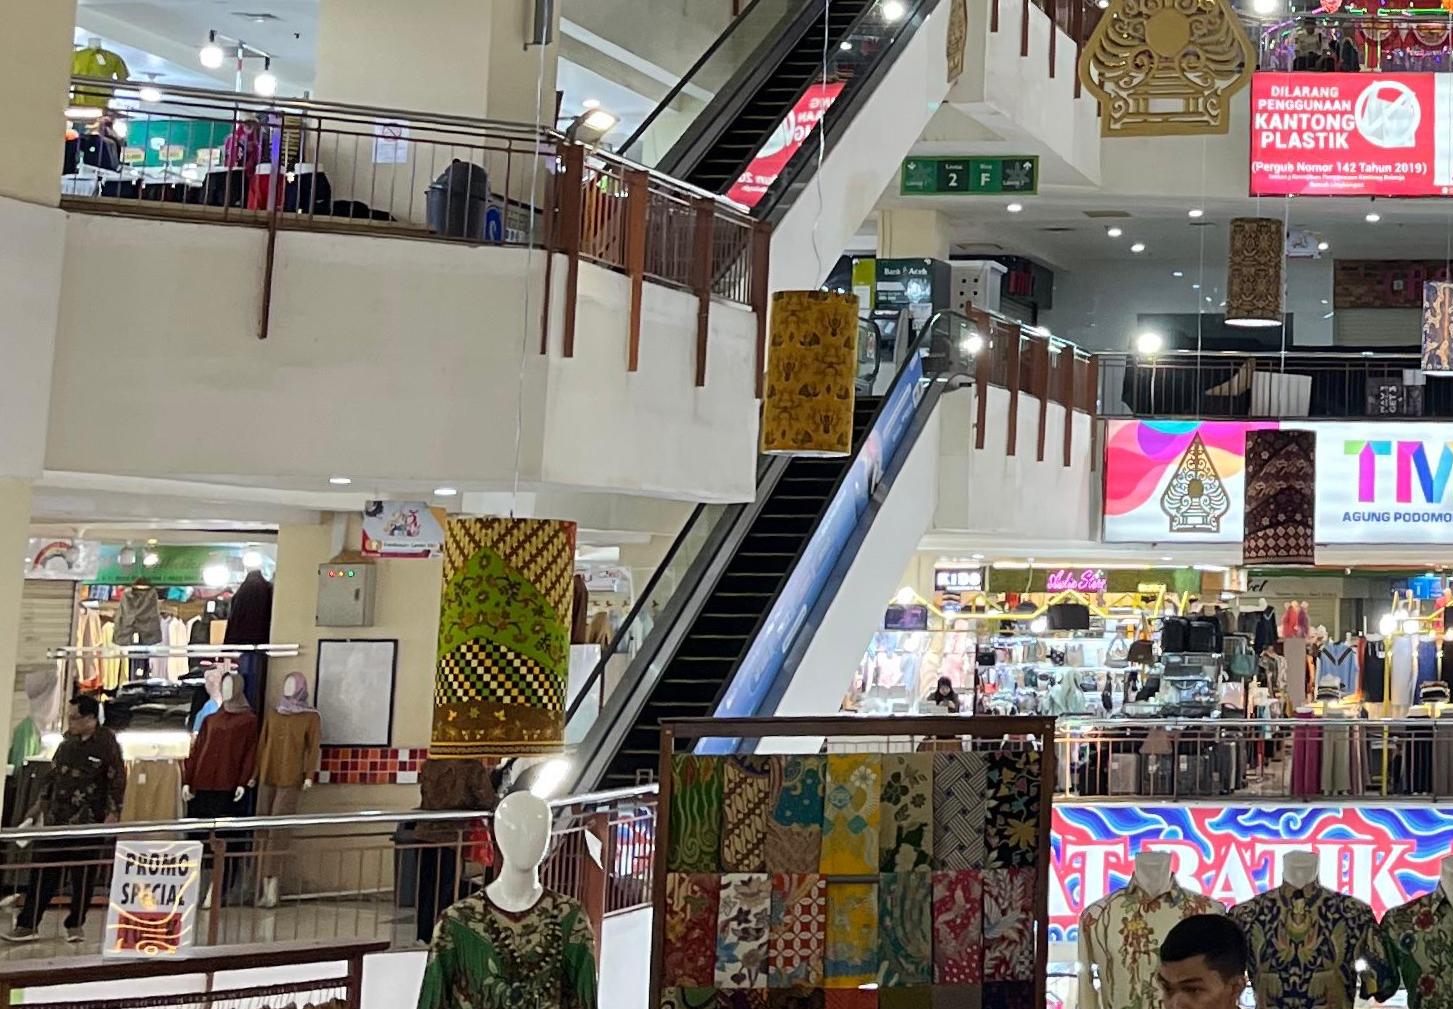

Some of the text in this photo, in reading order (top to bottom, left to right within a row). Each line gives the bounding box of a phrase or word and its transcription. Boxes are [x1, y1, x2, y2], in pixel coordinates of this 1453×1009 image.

[1271, 86, 1339, 98] DILARANG
[1258, 99, 1351, 111] PENGGUNAAN
[1255, 113, 1355, 131] KANTONG
[1261, 131, 1349, 149] PLASTIK
[1252, 161, 1427, 174] (Pergub Nomor 142 Tahun 2019)
[948, 173, 991, 186] 2 F
[1342, 511, 1391, 523] AGUNG
[125, 853, 190, 877] PROMO
[121, 883, 185, 906] SPECIAL
